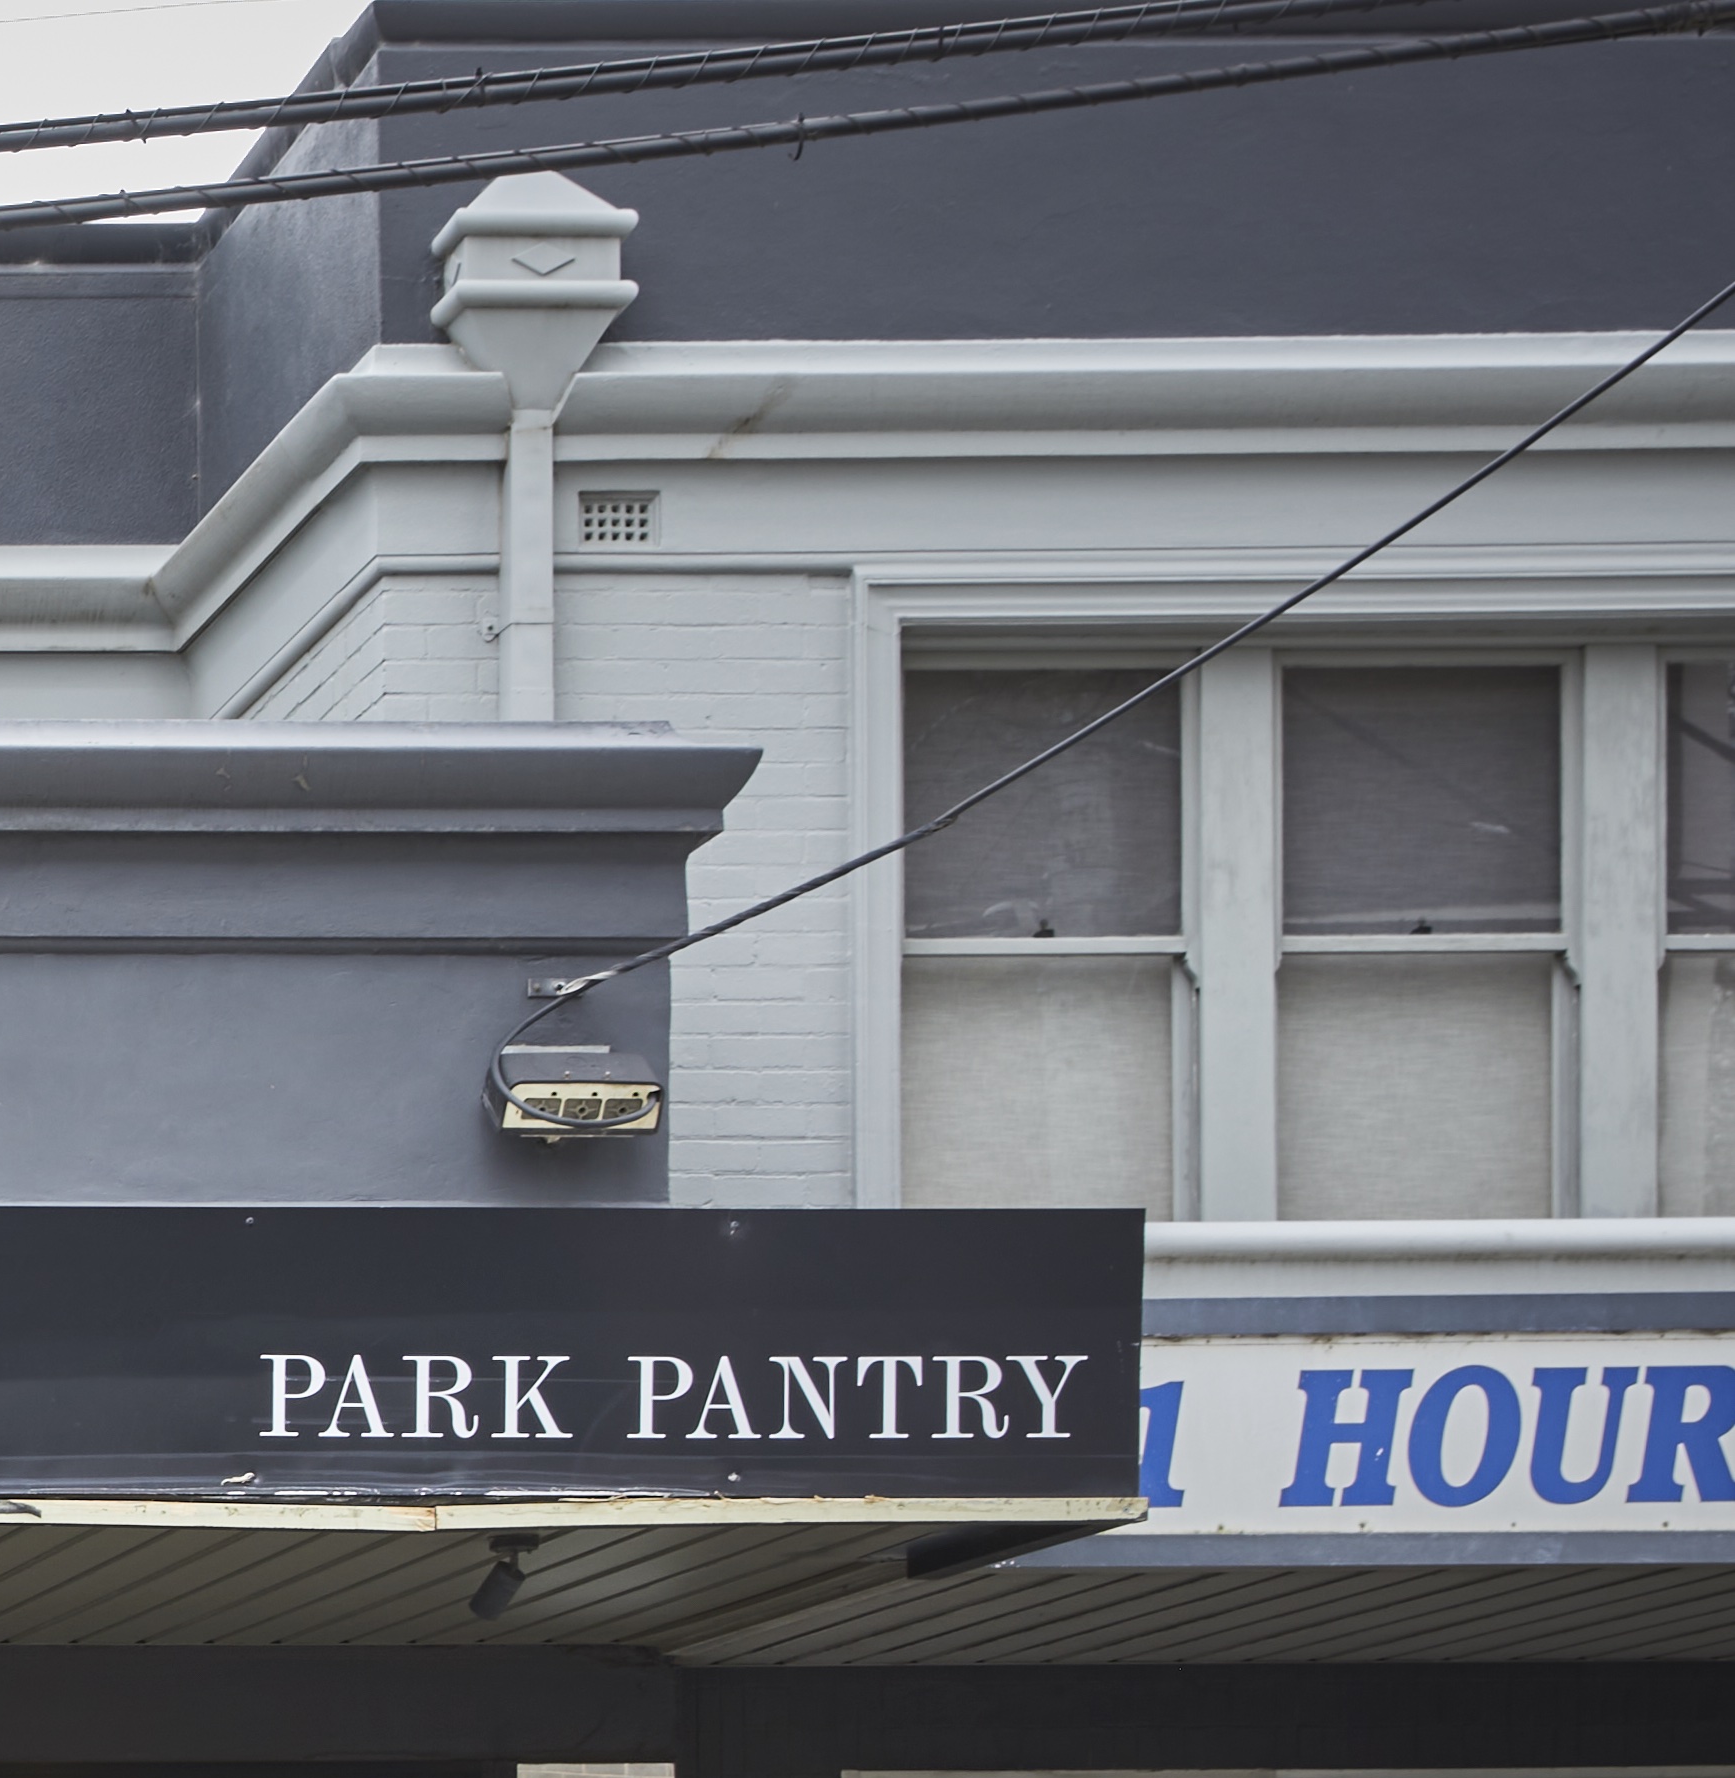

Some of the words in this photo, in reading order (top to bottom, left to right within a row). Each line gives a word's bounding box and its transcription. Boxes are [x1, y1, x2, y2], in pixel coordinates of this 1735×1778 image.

[259, 1354, 574, 1439] PARK
[626, 1355, 1090, 1440] PANTRY
[1140, 1381, 1185, 1508] 1
[1278, 1364, 1735, 1508] HOUR
